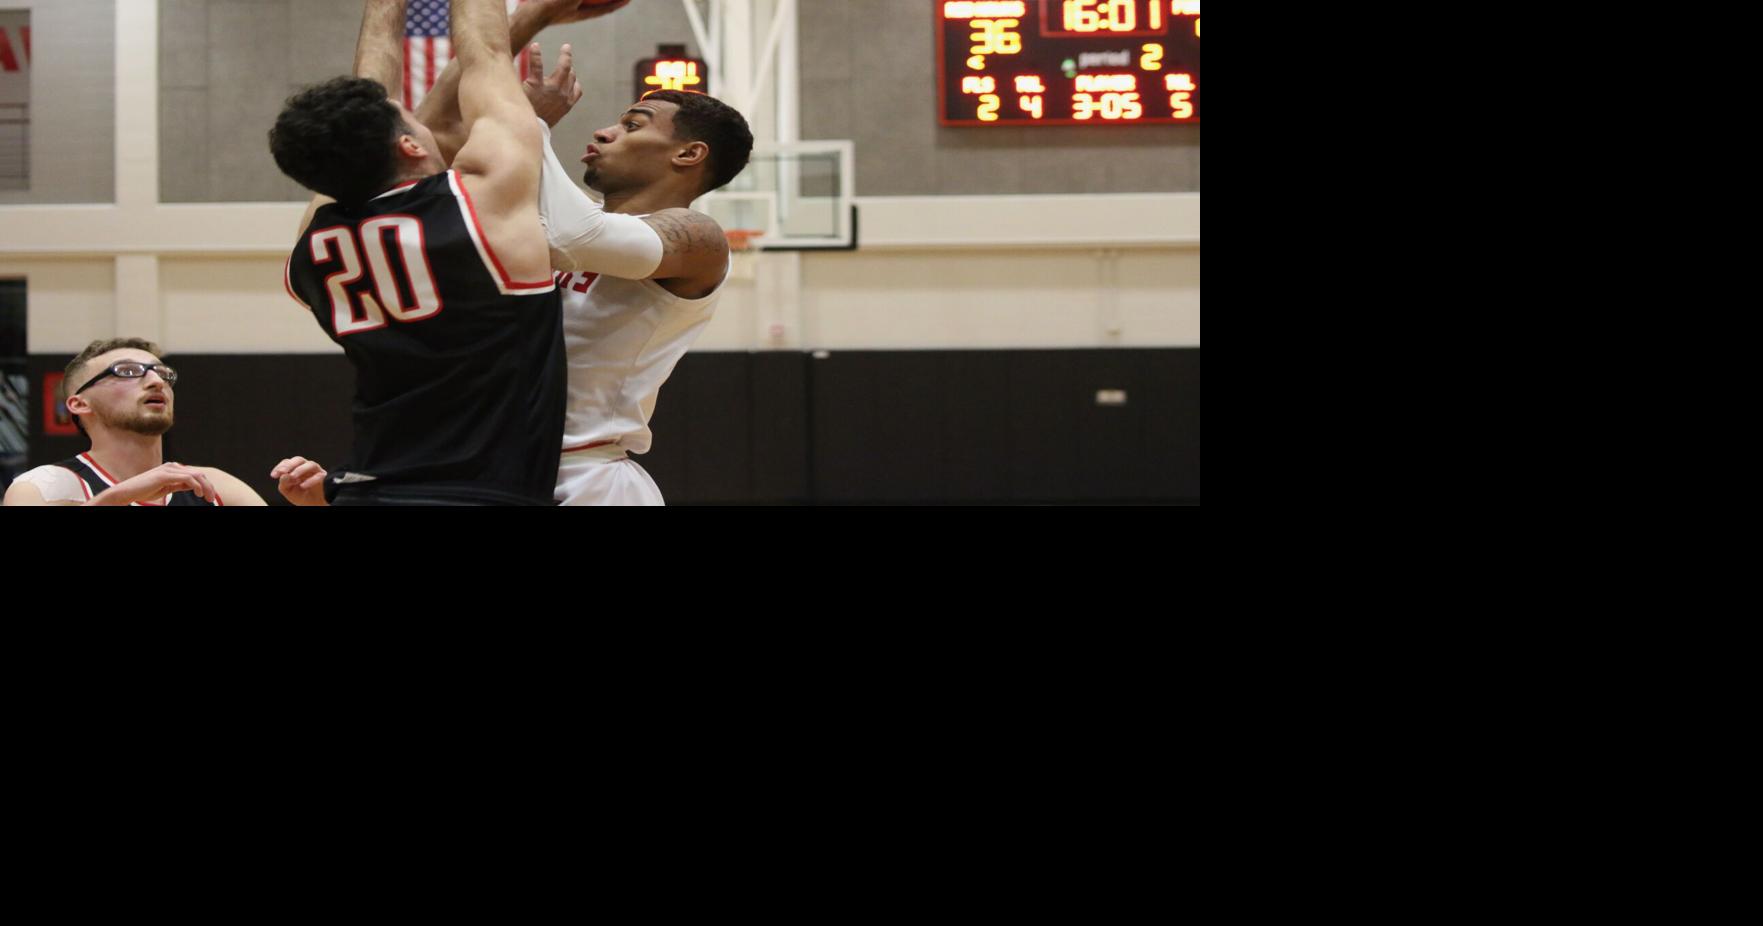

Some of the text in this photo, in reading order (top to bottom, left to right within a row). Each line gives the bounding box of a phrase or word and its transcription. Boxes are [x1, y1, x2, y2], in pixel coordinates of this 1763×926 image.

[1063, 0, 1161, 31] 16:01
[970, 18, 1021, 54] 36
[1140, 43, 1163, 70] 2
[977, 94, 1000, 121] 2
[1020, 95, 1043, 118] 4
[1170, 92, 1193, 118] 5
[310, 214, 443, 336] 20
